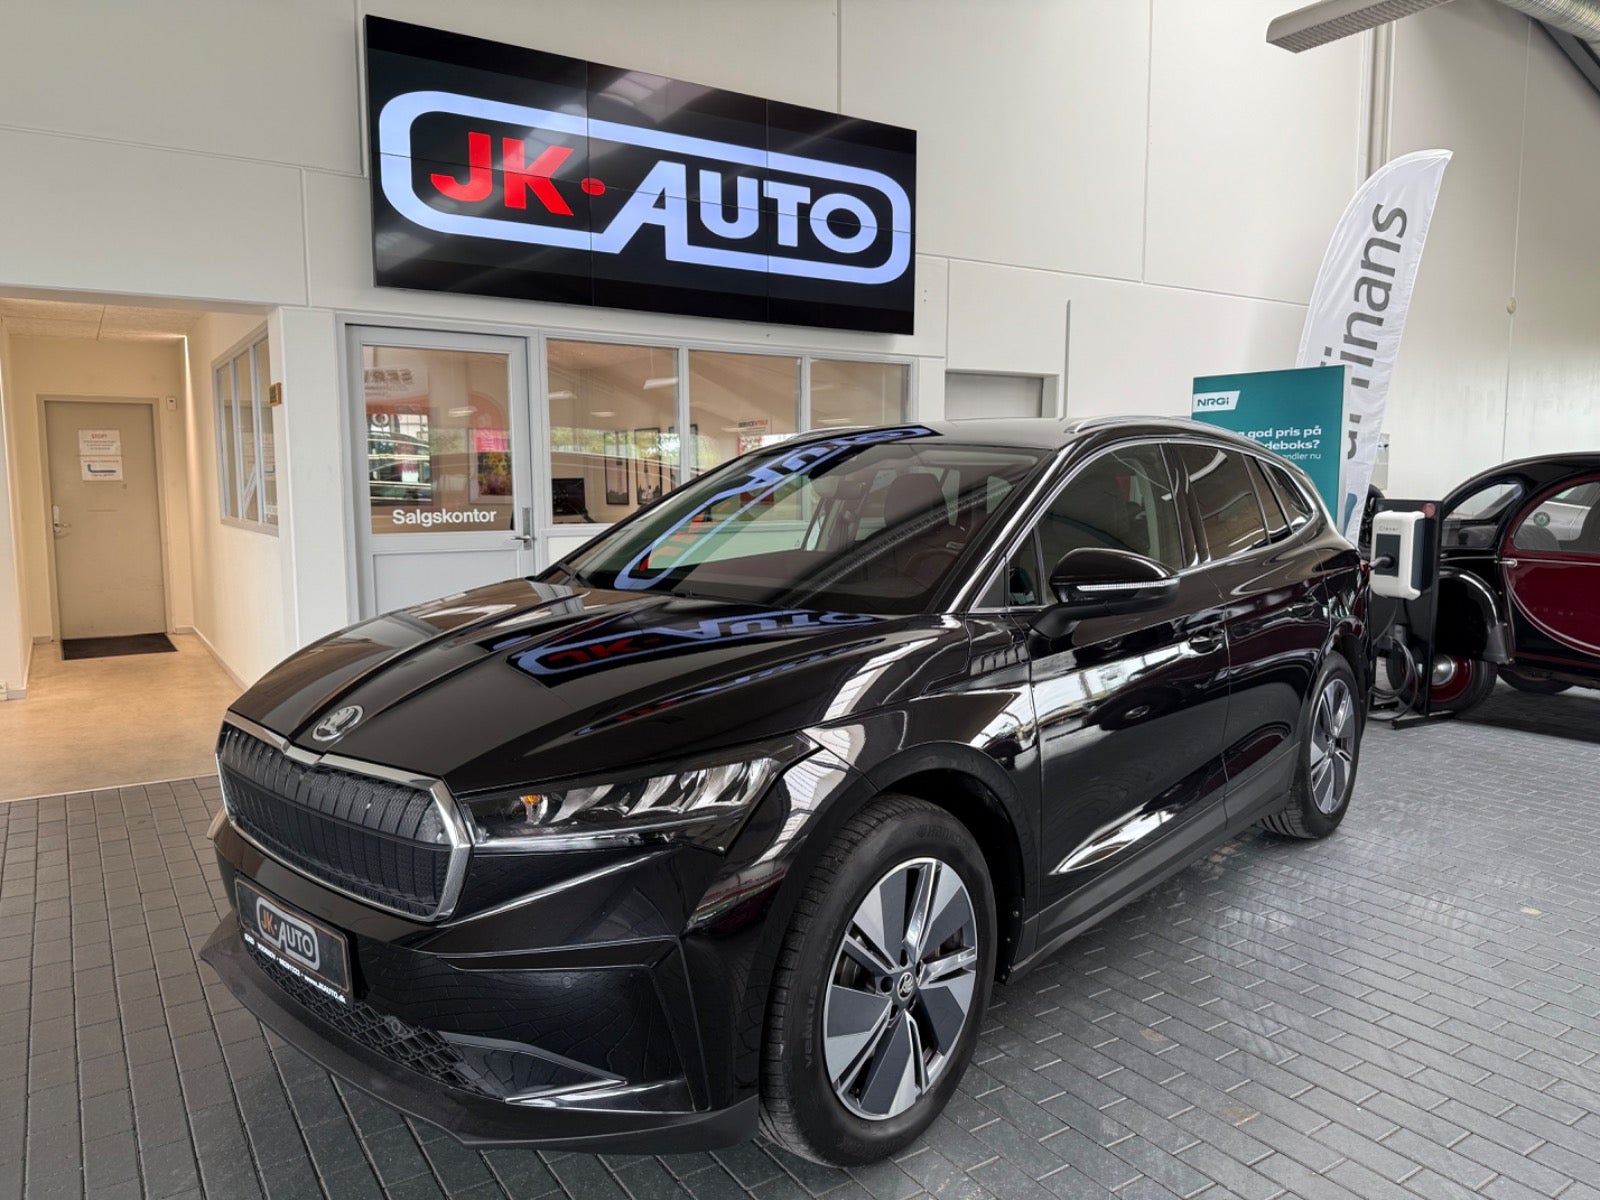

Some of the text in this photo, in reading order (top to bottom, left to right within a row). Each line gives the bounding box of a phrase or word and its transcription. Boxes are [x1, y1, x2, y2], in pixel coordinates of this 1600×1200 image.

[1247, 428, 1272, 440] god
[1275, 427, 1300, 439] pris
[1303, 425, 1321, 438] på
[1264, 439, 1320, 450] deboks?
[392, 508, 497, 527] Salgskontor
